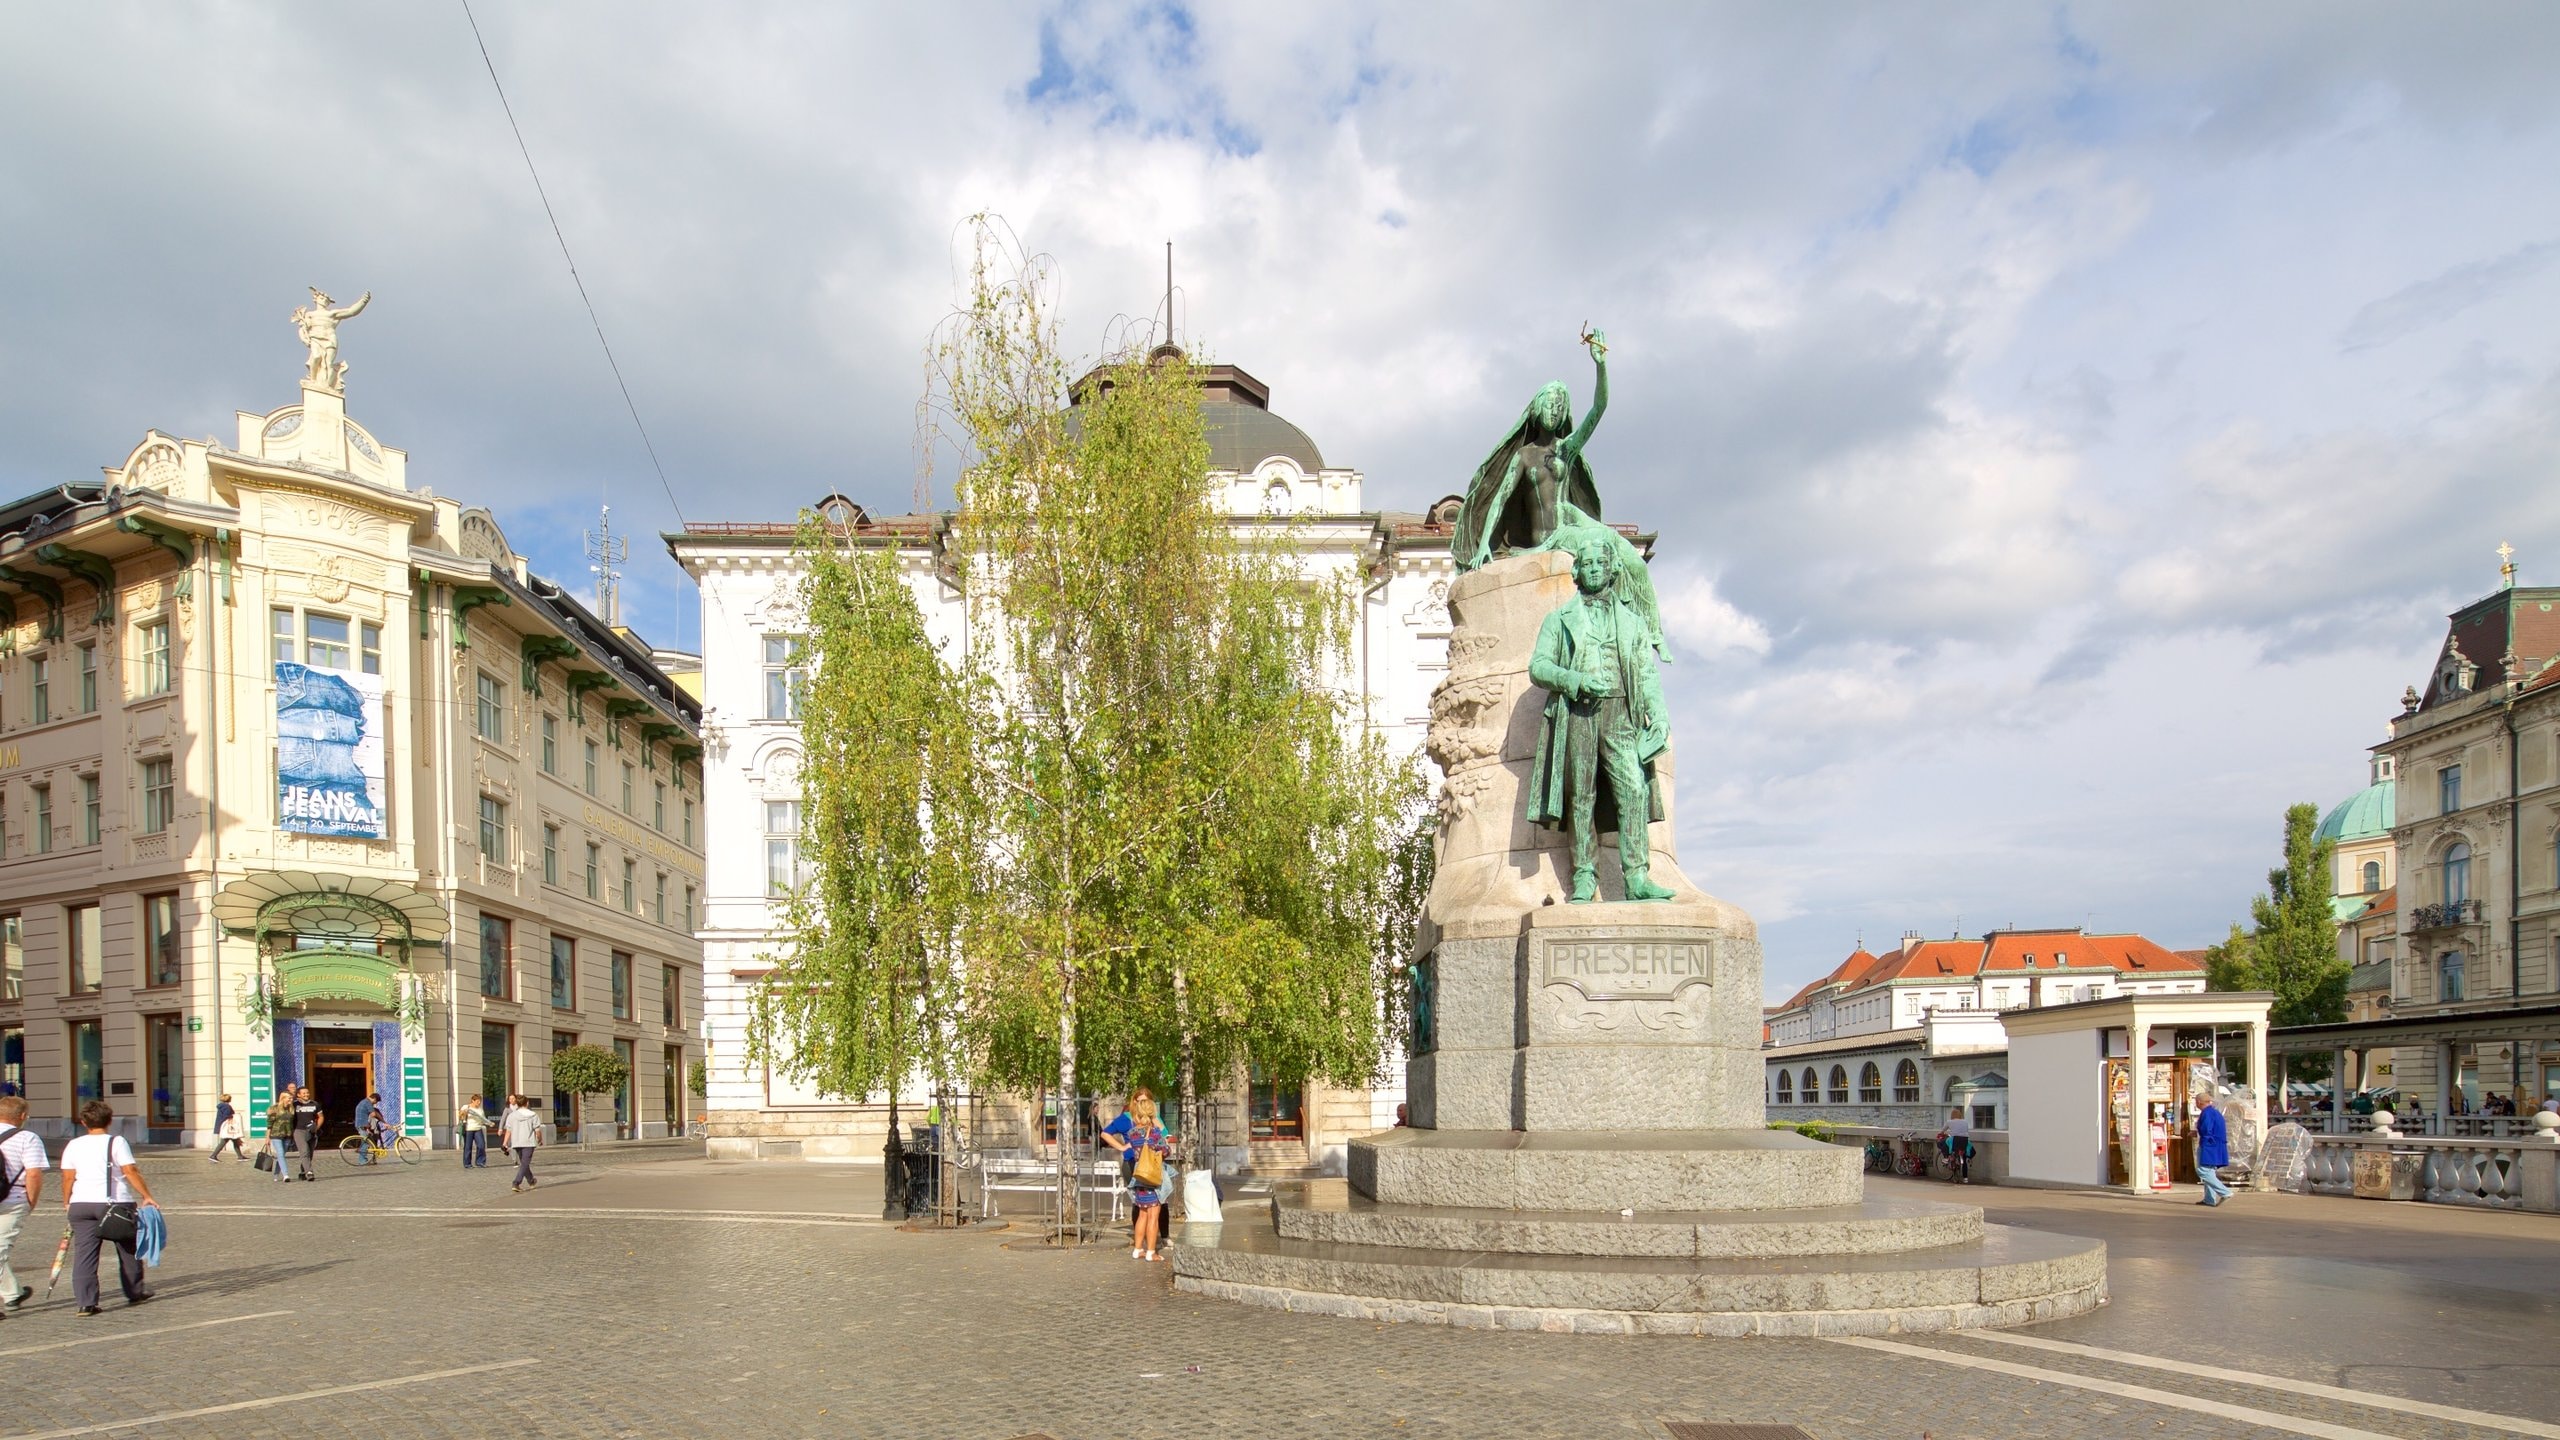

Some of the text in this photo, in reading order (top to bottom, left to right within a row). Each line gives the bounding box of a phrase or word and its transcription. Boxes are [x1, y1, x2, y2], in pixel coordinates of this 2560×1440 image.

[293, 508, 359, 536] 1903
[284, 785, 356, 808] JEANS
[283, 798, 382, 824] FESTIVAL
[329, 821, 381, 833] SEPTEMBER
[583, 805, 702, 874] GALERIJA EMPORIUM
[2176, 1036, 2212, 1050] kiosk
